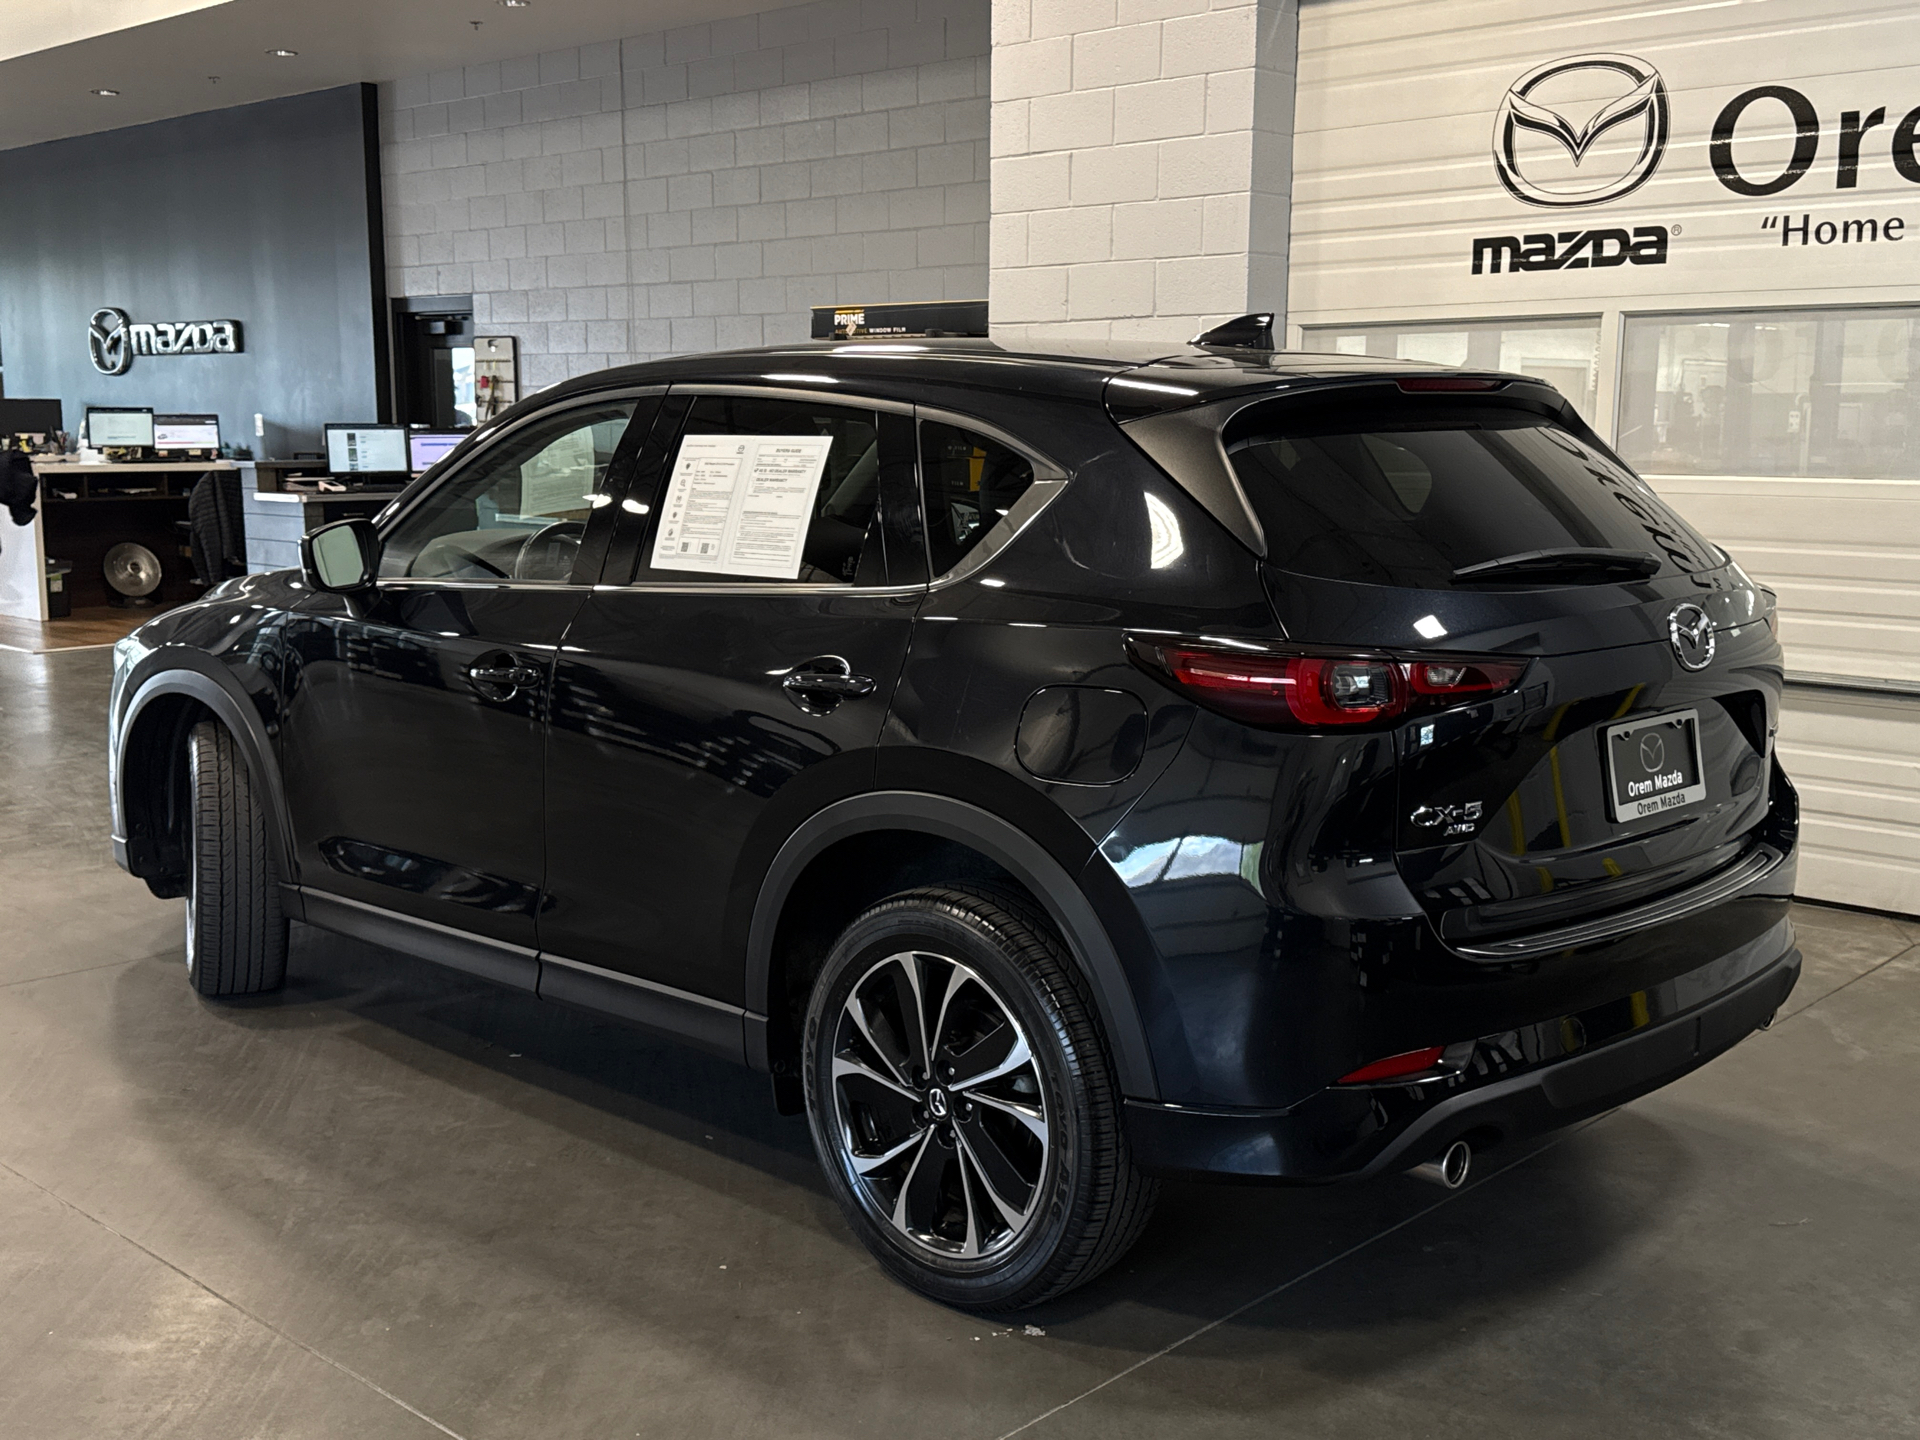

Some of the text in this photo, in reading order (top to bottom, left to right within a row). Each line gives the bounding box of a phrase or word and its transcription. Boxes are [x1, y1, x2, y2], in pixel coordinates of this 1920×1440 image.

[1471, 225, 1668, 275] mazda
[834, 313, 865, 326] PRIME
[129, 320, 243, 356] mazda
[1628, 769, 1684, 797] Orem Mazda
[1409, 799, 1484, 828] CX-5
[1636, 791, 1686, 816] Orem Mazda
[1443, 822, 1476, 837] AWD
